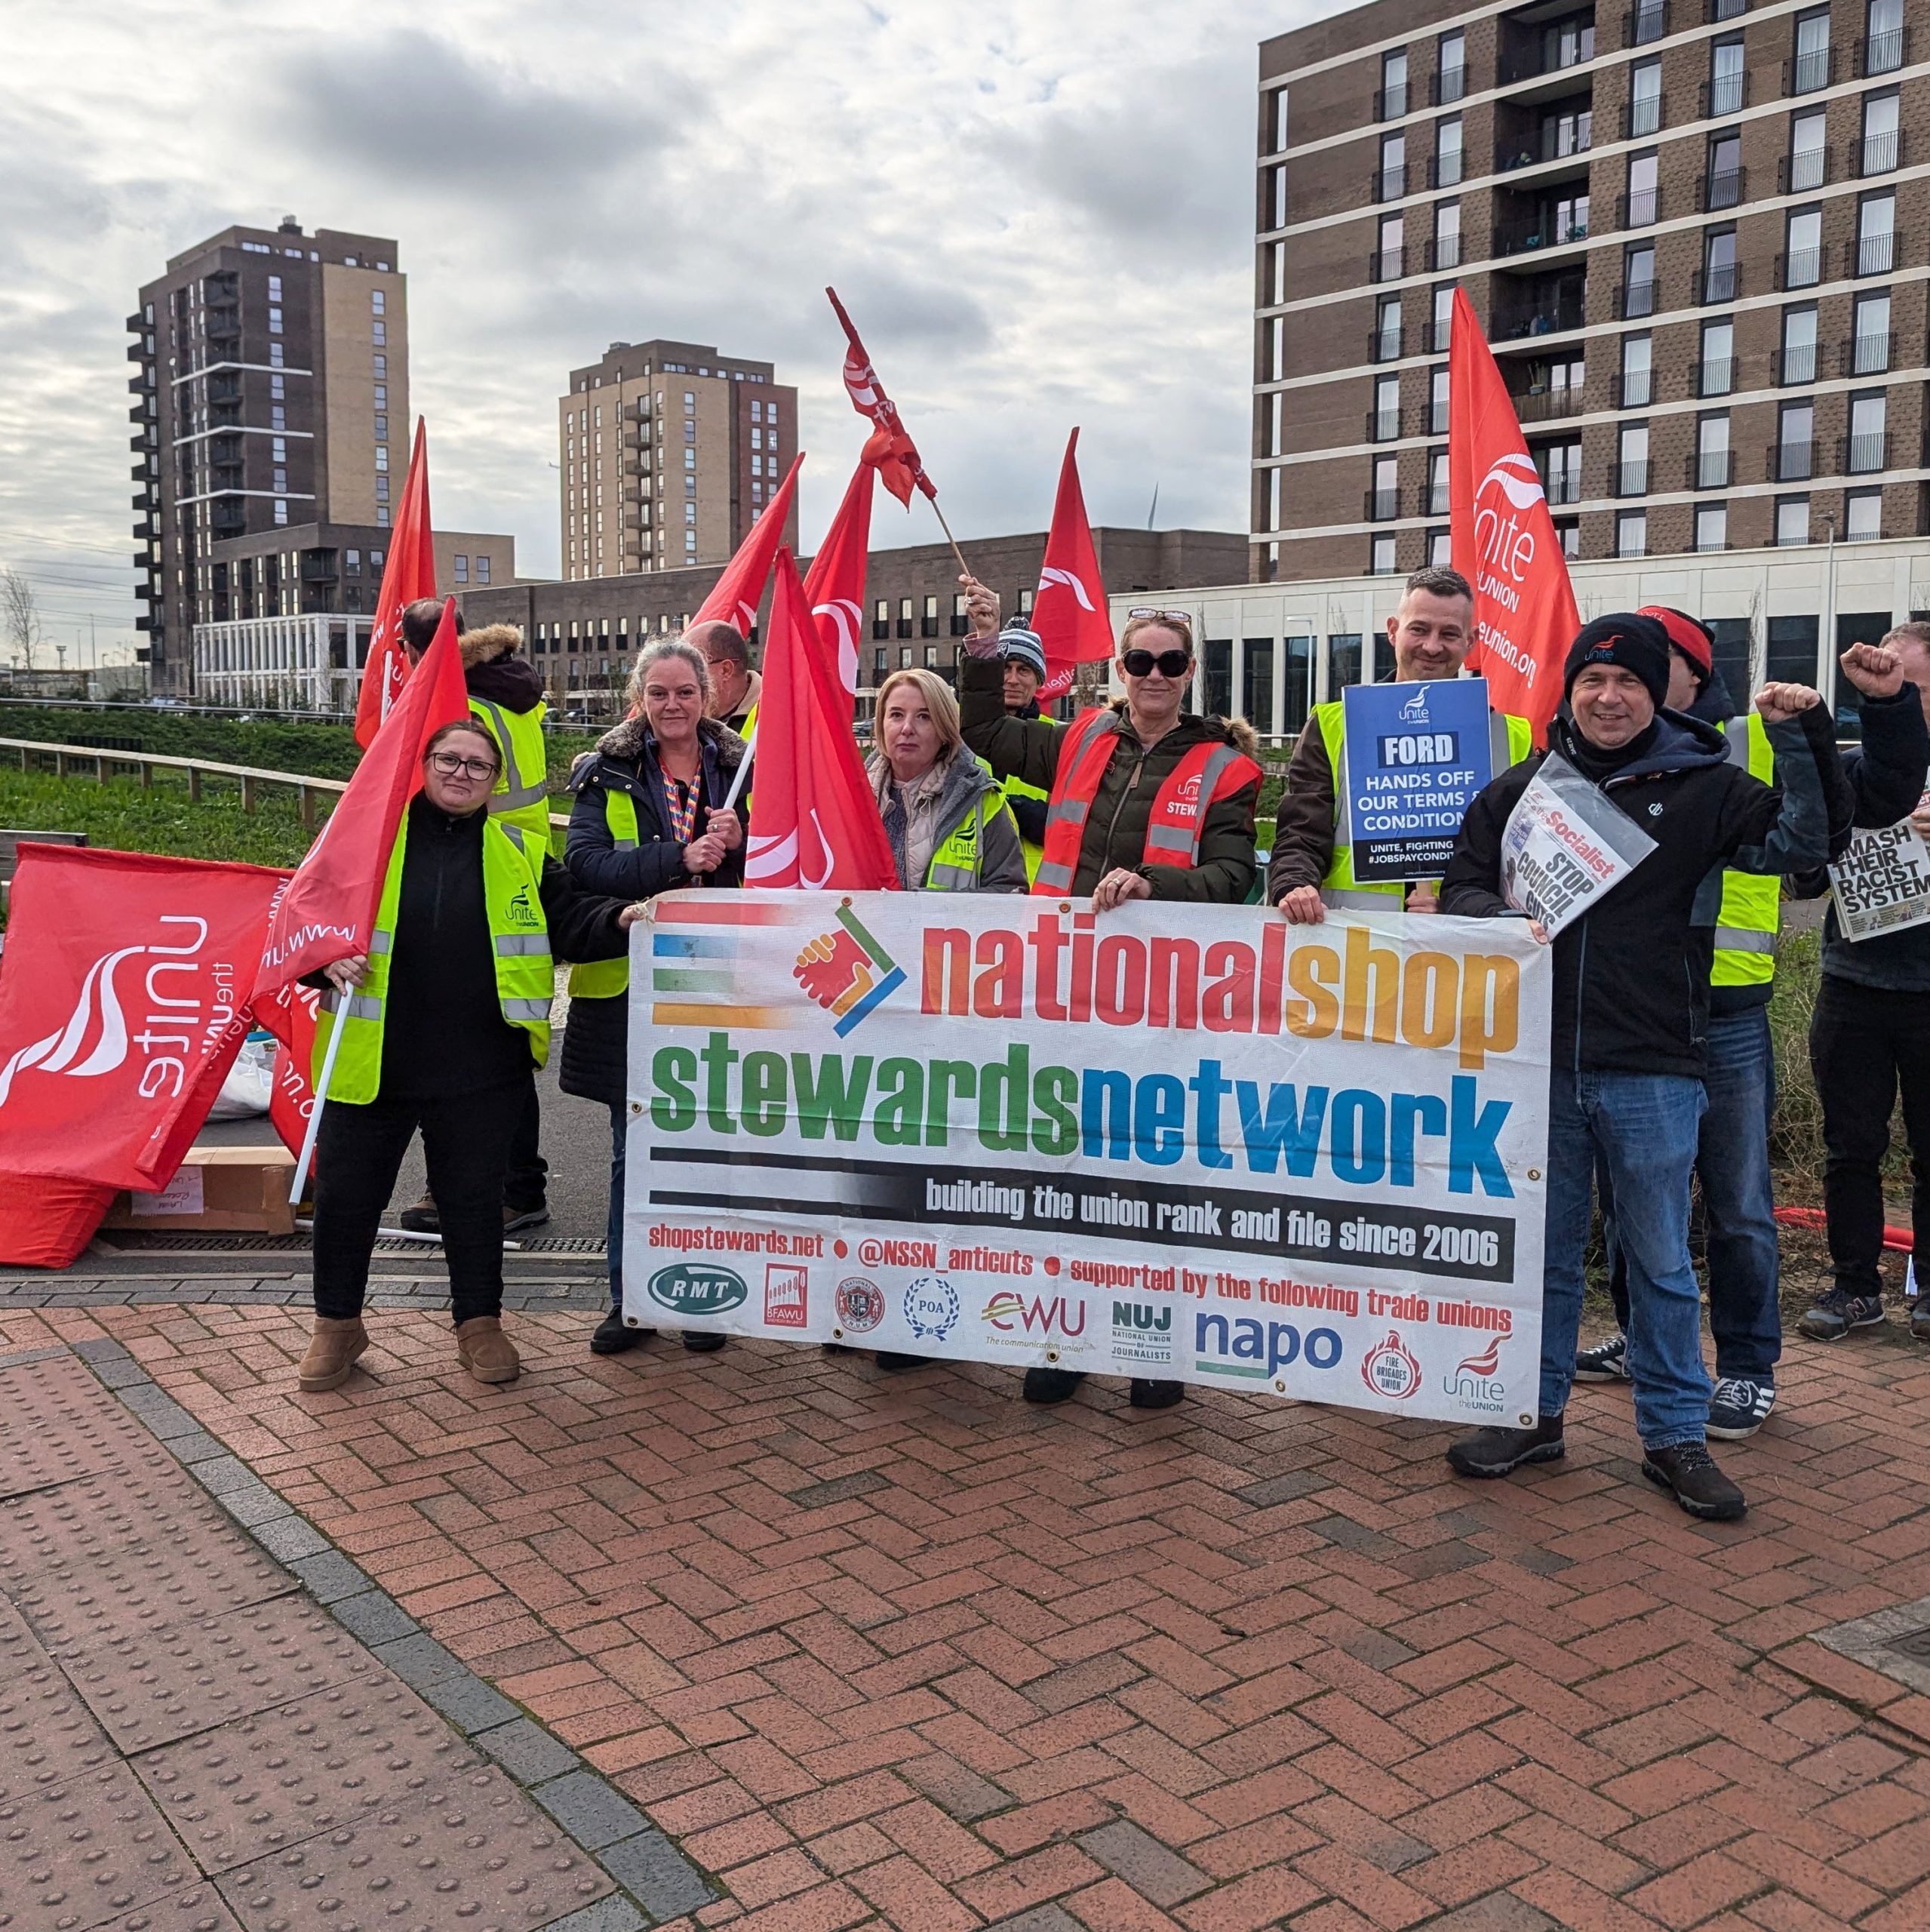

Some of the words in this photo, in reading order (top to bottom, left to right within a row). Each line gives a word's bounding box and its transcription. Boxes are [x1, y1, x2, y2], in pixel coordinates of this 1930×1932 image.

[1474, 509, 1535, 582] nite
[1477, 571, 1520, 613] UNION
[1479, 621, 1537, 688] eunion.org
[1584, 649, 1614, 661] unite
[1399, 707, 1430, 720] unite
[1384, 734, 1453, 765] FORD
[1178, 784, 1199, 795] uni
[1366, 772, 1431, 790] HANDS
[1437, 771, 1474, 786] OFF
[1166, 801, 1197, 816] STEW
[1357, 795, 1399, 811] OUR
[1403, 791, 1465, 808] TERMS
[1363, 811, 1464, 831] CONDITION
[1370, 843, 1403, 854] UNITE,
[1406, 840, 1454, 853] FIGHTING
[1546, 810, 1616, 879] Socialist
[1844, 825, 1912, 860] MASH
[1368, 851, 1455, 864] #JOBSPAYCONDIT
[1833, 848, 1901, 879] THEIR
[1546, 851, 1594, 897] STOP
[1838, 860, 1919, 897] RACIST
[1517, 851, 1575, 918] COUNCIL
[1844, 874, 1930, 914] SYSTEM
[505, 906, 538, 920] unite
[1526, 890, 1556, 932] CUTS
[650, 1032, 1516, 1198] stewardsnetwork
[926, 1177, 1025, 1221] building
[1033, 1185, 1074, 1220] the
[1080, 1191, 1149, 1229] union
[1156, 1201, 1223, 1237] rank
[1231, 1207, 1280, 1243] and
[1287, 1209, 1331, 1248] file
[1338, 1216, 1416, 1257] since
[1422, 1223, 1498, 1267] 2006
[649, 1223, 824, 1259] shopstewards.net
[858, 1238, 1034, 1276] @NSSN_anticuts
[1070, 1258, 1176, 1292] supported
[1182, 1268, 1208, 1300] by
[1215, 1272, 1251, 1300] the
[1258, 1276, 1359, 1318] following
[1366, 1288, 1429, 1322] trade
[1437, 1300, 1513, 1333] unions
[670, 1279, 730, 1299] RMT
[767, 1308, 804, 1320] BFAWU
[918, 1300, 945, 1313] POA
[987, 1291, 1085, 1337] CWU
[1112, 1300, 1172, 1331] NUJ
[986, 1336, 1000, 1345] The
[1062, 1343, 1083, 1353] union
[1111, 1330, 1146, 1341] NATIONAL
[1148, 1334, 1171, 1343] UNION
[1196, 1312, 1343, 1380] napo
[1111, 1346, 1171, 1360] JOURNALISTS
[1385, 1355, 1399, 1367] FIRE
[1376, 1365, 1407, 1381] BRIGADES
[1381, 1379, 1401, 1391] UNION
[1443, 1375, 1504, 1401] unite
[1458, 1400, 1504, 1412] theUNION
